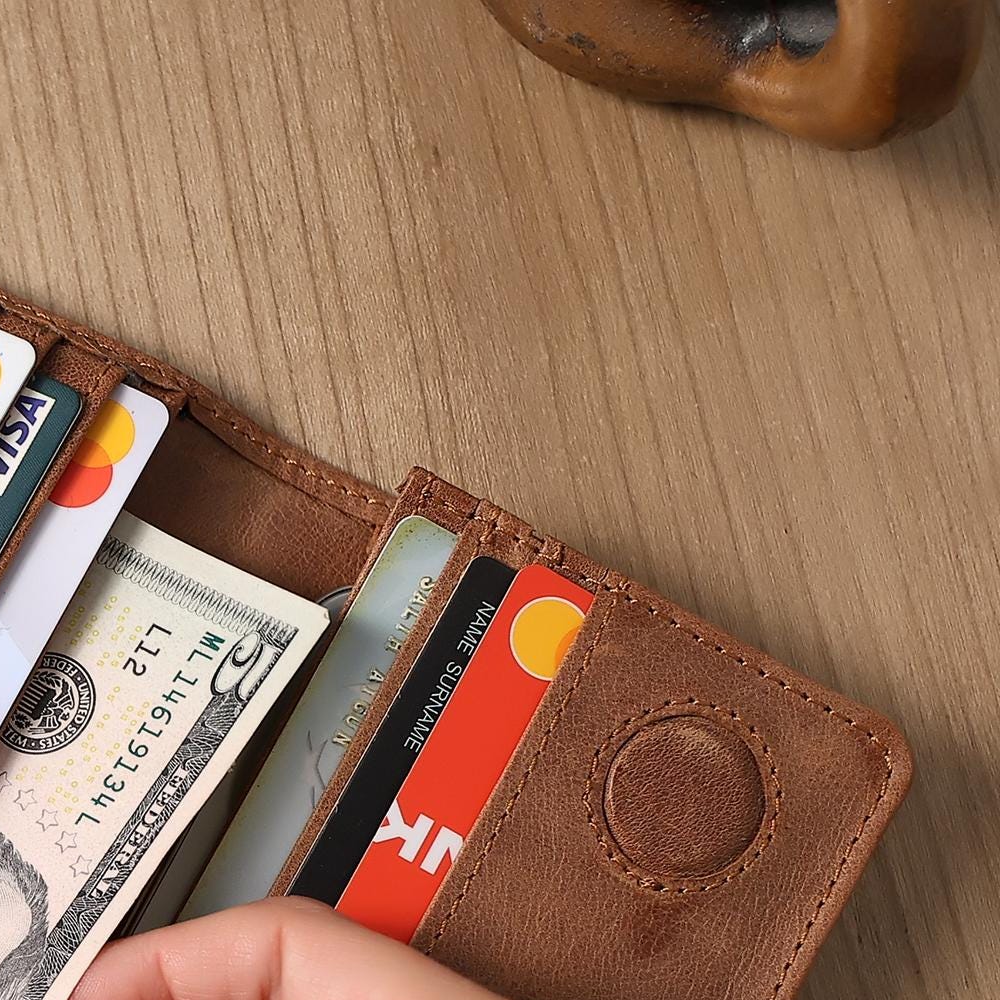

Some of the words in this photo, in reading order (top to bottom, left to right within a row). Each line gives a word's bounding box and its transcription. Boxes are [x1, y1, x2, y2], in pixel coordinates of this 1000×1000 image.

[122, 622, 172, 677] L12
[455, 598, 496, 657] NAME
[43, 658, 78, 677] FEDER
[203, 625, 281, 710] 5
[74, 682, 90, 724] UNITED
[401, 658, 464, 754] SURNAME
[39, 724, 77, 749] STATES
[88, 762, 190, 901] FEDERAL
